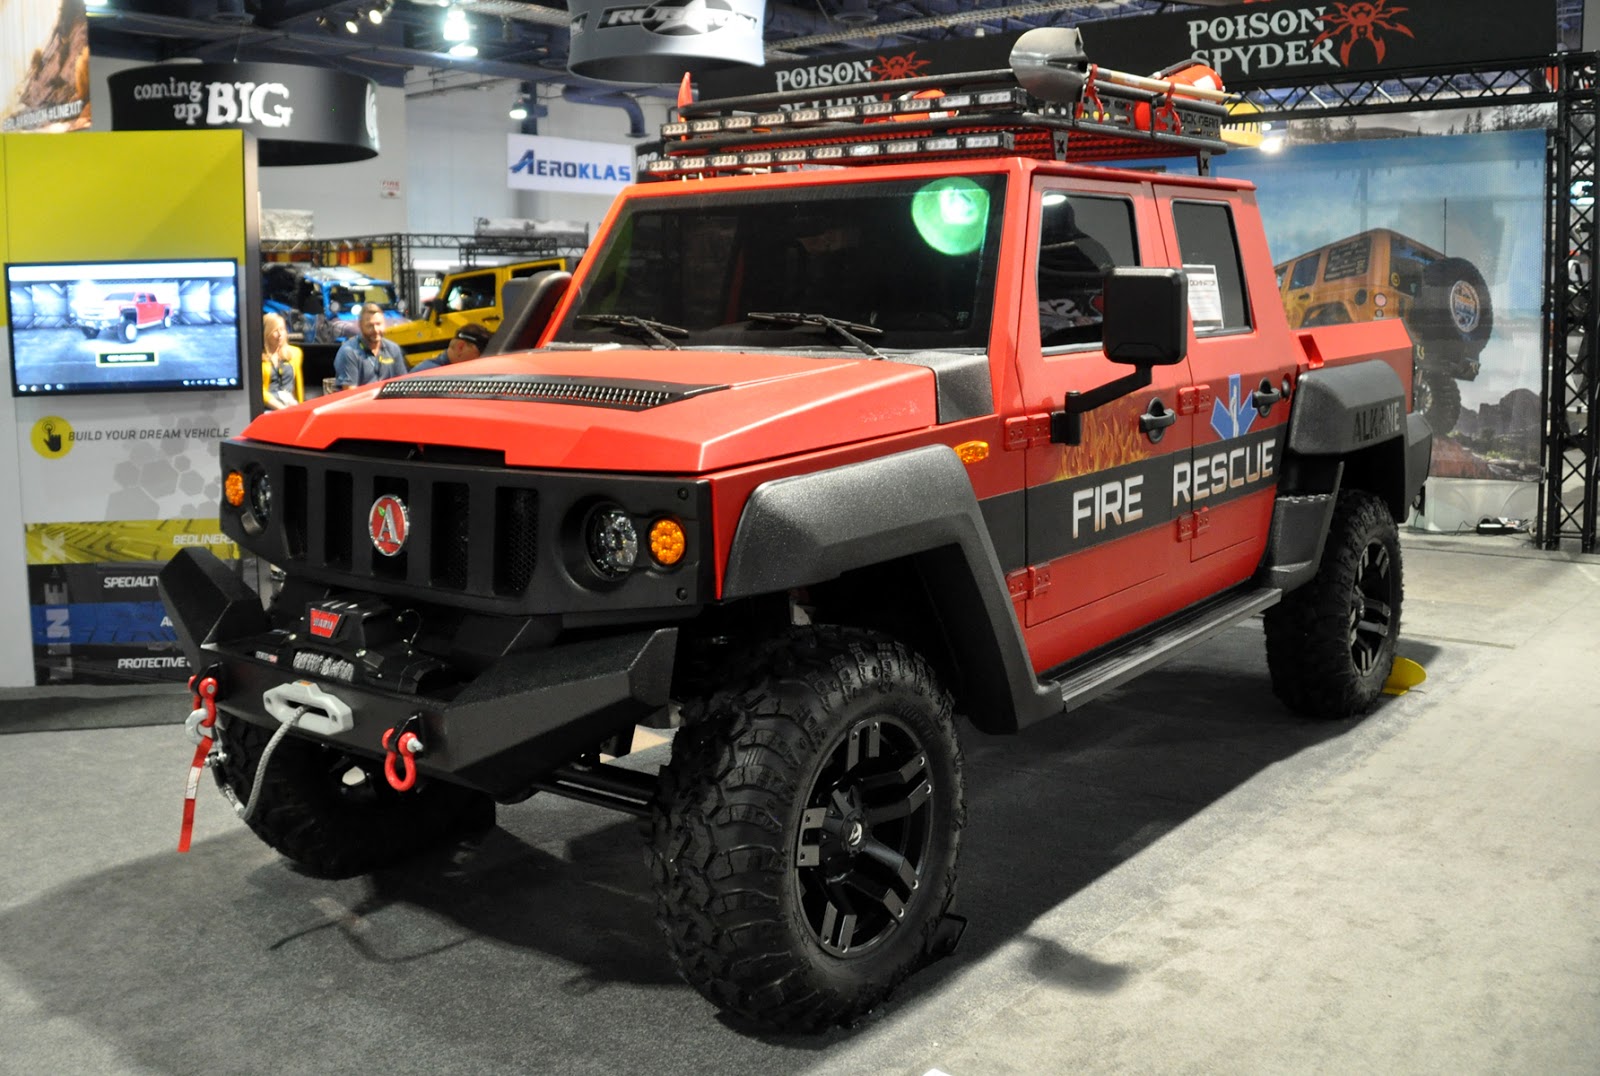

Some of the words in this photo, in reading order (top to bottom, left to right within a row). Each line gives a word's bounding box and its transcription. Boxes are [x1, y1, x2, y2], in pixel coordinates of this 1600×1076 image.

[1187, 6, 1327, 49] POISON
[133, 77, 202, 100] coming
[775, 60, 873, 92] POISON
[173, 102, 202, 125] up
[205, 81, 294, 127] BIG
[509, 149, 631, 181] AEROKLAS
[68, 430, 102, 442] BUILD
[105, 429, 137, 440] YOUR
[139, 429, 181, 440] DREAM
[184, 427, 231, 439] VEHICLE
[1072, 474, 1144, 539] FIRE
[1173, 438, 1276, 507] RESCUE
[117, 657, 186, 669] PROTECTIVE
